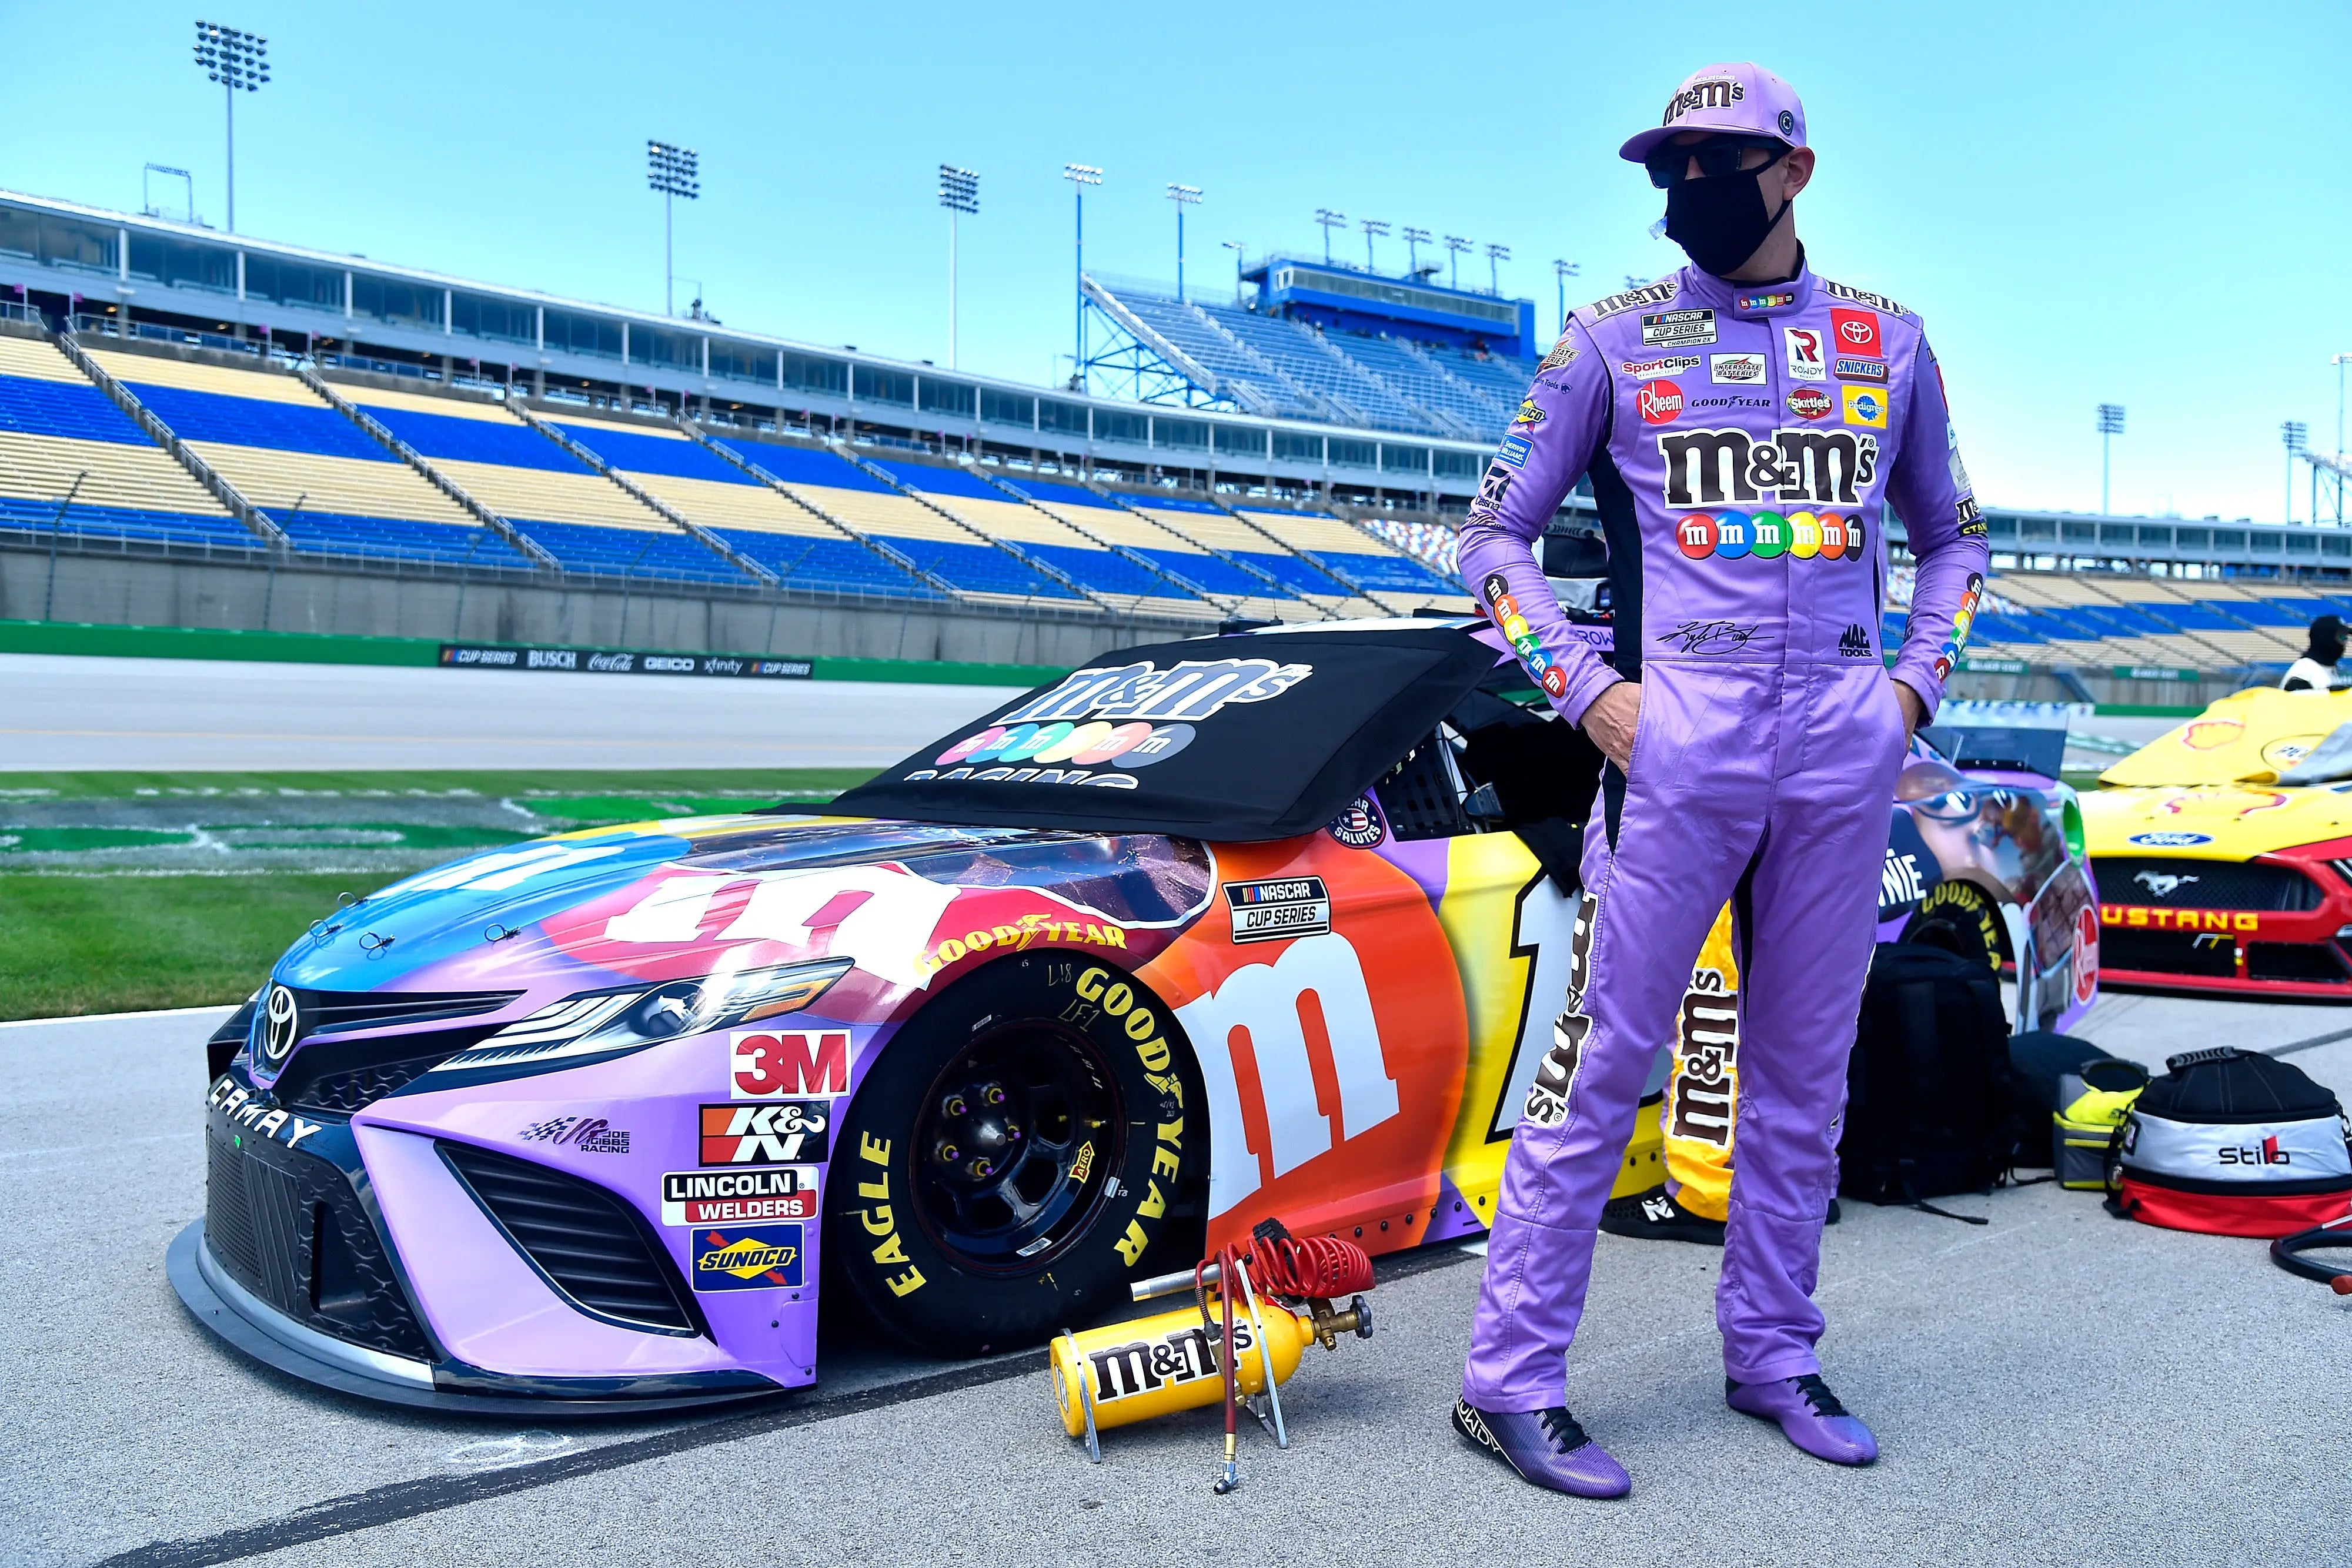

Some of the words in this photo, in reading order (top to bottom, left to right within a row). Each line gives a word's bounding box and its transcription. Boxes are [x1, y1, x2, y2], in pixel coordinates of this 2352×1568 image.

[1665, 312, 1703, 323] NASCAR
[1653, 326, 1671, 337] CUP
[1673, 324, 1705, 334] SERIES
[1667, 338, 1701, 347] CHAMPION
[1623, 357, 1700, 374] SportClips
[1790, 365, 1823, 375] ROWDY
[1837, 360, 1883, 376] SNICKERS
[1545, 379, 1559, 389] Tools
[1639, 381, 1682, 419] Rheem
[1691, 396, 1770, 408] GOODYEAR
[1790, 397, 1830, 410] Skittles
[1847, 400, 1884, 413] Pedigree
[1505, 440, 1527, 454] SHERWIN
[1475, 495, 1501, 511] Cessna
[1685, 525, 1708, 546] m
[1719, 524, 1744, 544] m
[1755, 524, 1780, 544] m
[1795, 524, 1815, 545] m
[1823, 525, 1841, 546] m
[1847, 526, 1860, 547] m
[1576, 630, 1613, 646] ROW
[1839, 623, 1870, 648] MAC
[459, 648, 481, 663] CUP
[479, 650, 518, 665] SERIES
[527, 649, 578, 669] BUSCH
[644, 656, 696, 671] GEICO
[703, 657, 743, 675] xfinity
[763, 662, 781, 674] CUP
[780, 663, 811, 676] SERIES
[1838, 648, 1873, 657] TOOLS
[1334, 824, 1381, 844] SALUTES
[1259, 882, 1311, 901] NASCAR
[1246, 909, 1272, 928] CUP
[1274, 906, 1317, 924] SERIES
[2102, 905, 2259, 931] USTANG
[913, 913, 1128, 976] GOODYEAR
[734, 1034, 847, 1095] 3M
[1075, 967, 1185, 1267] GOODYEAR
[580, 1145, 630, 1154] RACING
[2219, 1135, 2291, 1166] Stilo
[1077, 1148, 1091, 1176] AERO
[670, 1173, 791, 1199] LINCOLN
[698, 1199, 804, 1221] WELDERS
[858, 1130, 927, 1298] EAGLE
[701, 1246, 797, 1270] SUNOCO
[1459, 1396, 1500, 1453] OWDY
